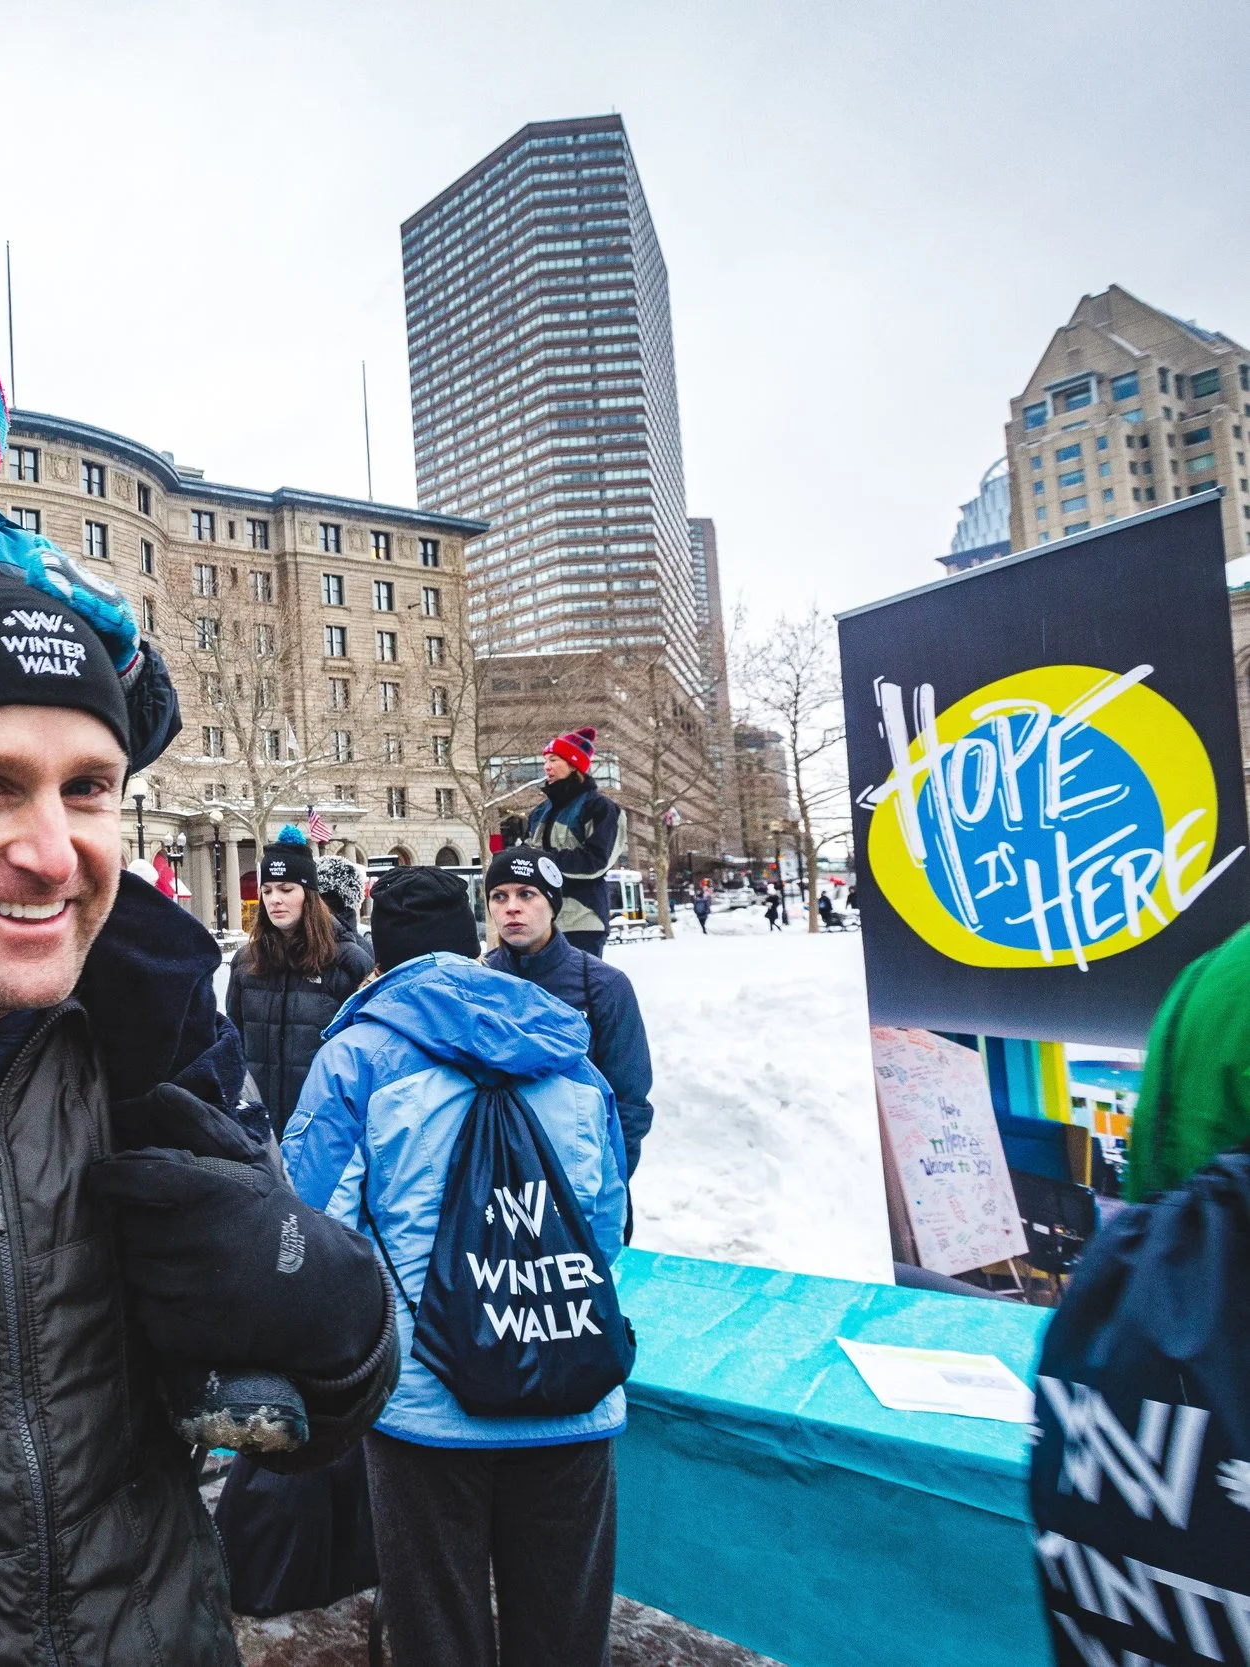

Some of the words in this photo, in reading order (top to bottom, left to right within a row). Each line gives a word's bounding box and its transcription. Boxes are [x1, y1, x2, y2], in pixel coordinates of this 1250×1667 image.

[0, 635, 87, 661] WINTER
[17, 654, 82, 677] WALK
[856, 664, 1154, 932] HOPE
[510, 865, 534, 873] WINTER
[513, 869, 531, 877] WALK
[974, 841, 1021, 900] IS
[1004, 807, 1246, 973] HERE
[280, 1220, 291, 1250] FACE
[288, 1213, 299, 1253] NORTH
[466, 1252, 605, 1296] WINTER
[483, 1299, 603, 1343] WALK
